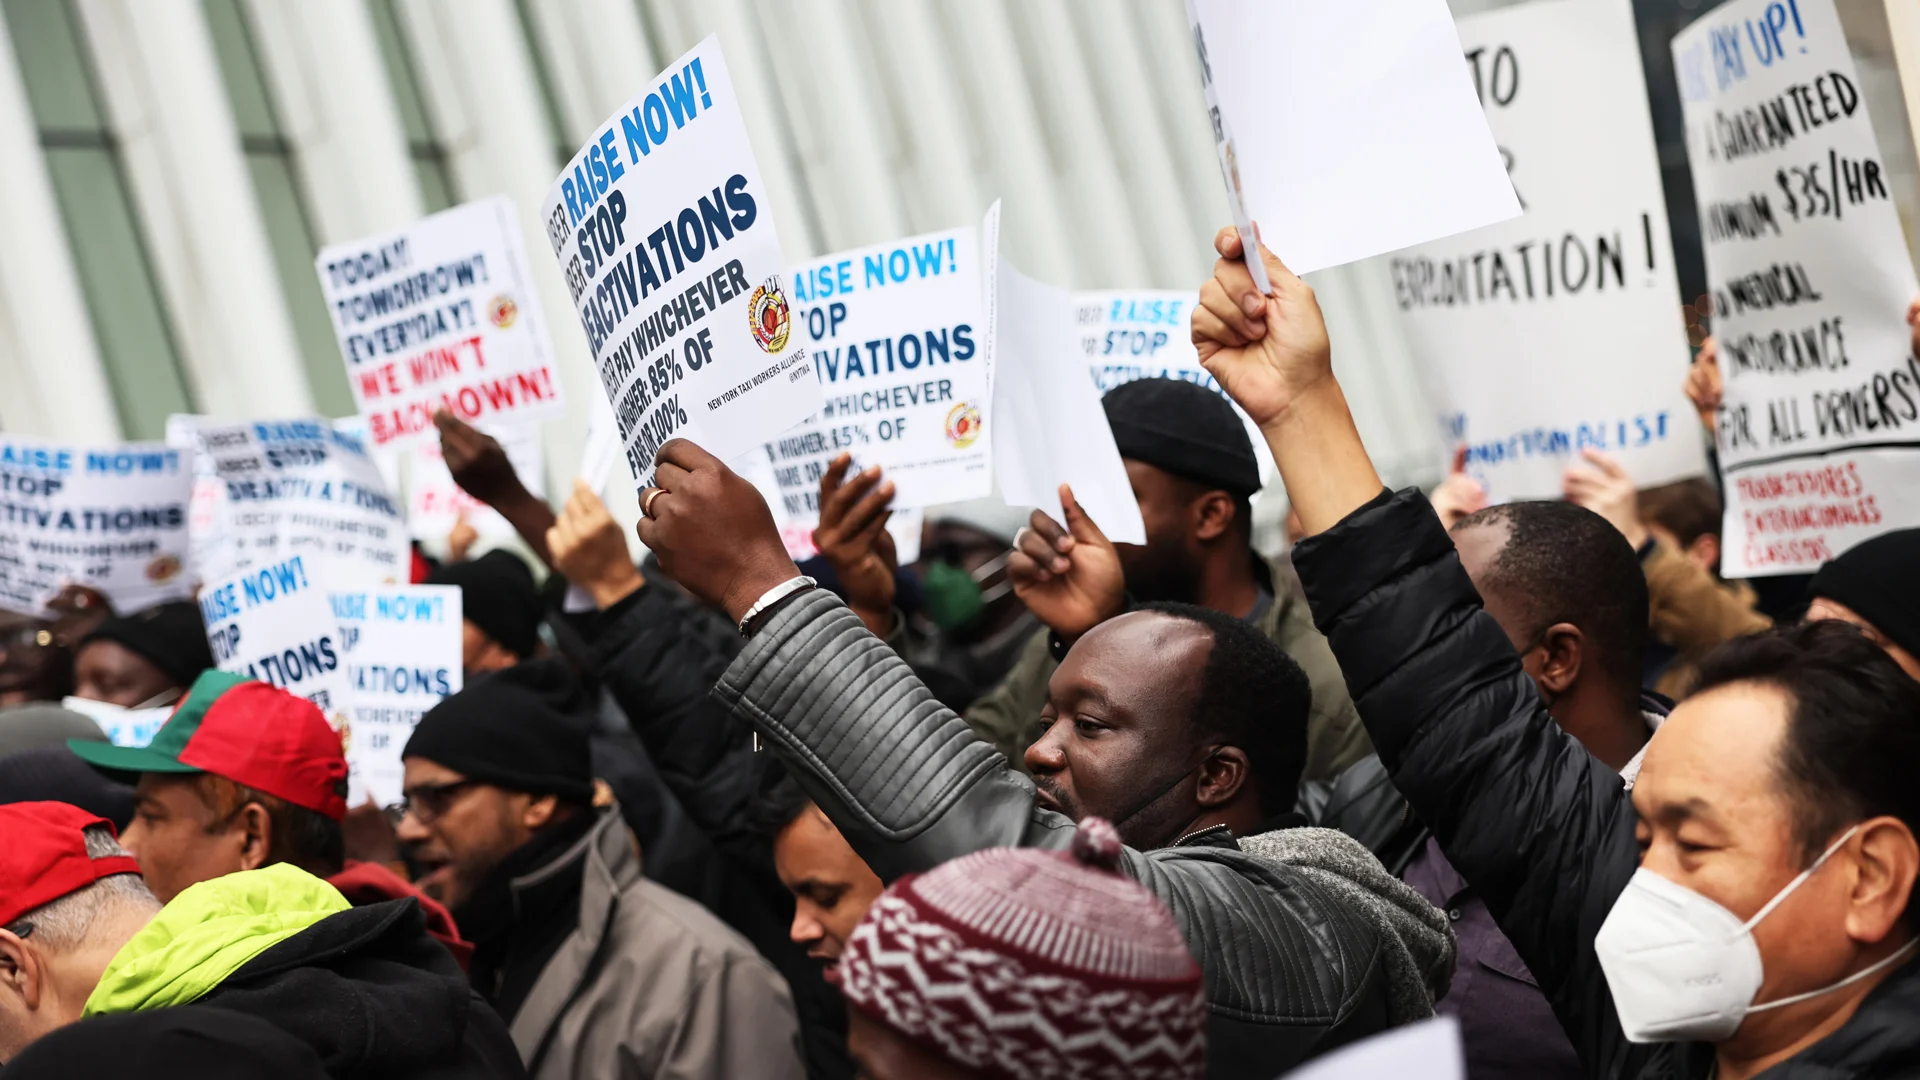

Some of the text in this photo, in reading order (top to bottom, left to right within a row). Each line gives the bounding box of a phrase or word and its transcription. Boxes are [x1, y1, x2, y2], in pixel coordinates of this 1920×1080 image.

[561, 127, 625, 229] RAISE
[620, 56, 713, 166] NOW!
[1777, 148, 1887, 221] $35/HR
[577, 189, 627, 279] STOP
[864, 238, 957, 288] NOW!
[613, 332, 636, 384] PAY
[631, 258, 750, 361] WHICHEVER
[800, 302, 847, 340] OP
[1103, 330, 1168, 355] STOP
[618, 376, 653, 435] HIGHER:
[648, 349, 684, 398] 85%
[683, 327, 714, 371] OF
[707, 348, 806, 411] NEW YORK TAXI WORKERS ALLIANCE
[626, 434, 652, 480] FARE
[640, 422, 657, 455] OR
[650, 394, 688, 446] 100%
[879, 417, 907, 441] OF
[241, 555, 308, 608] NOW!
[245, 636, 337, 688] ATIONS
